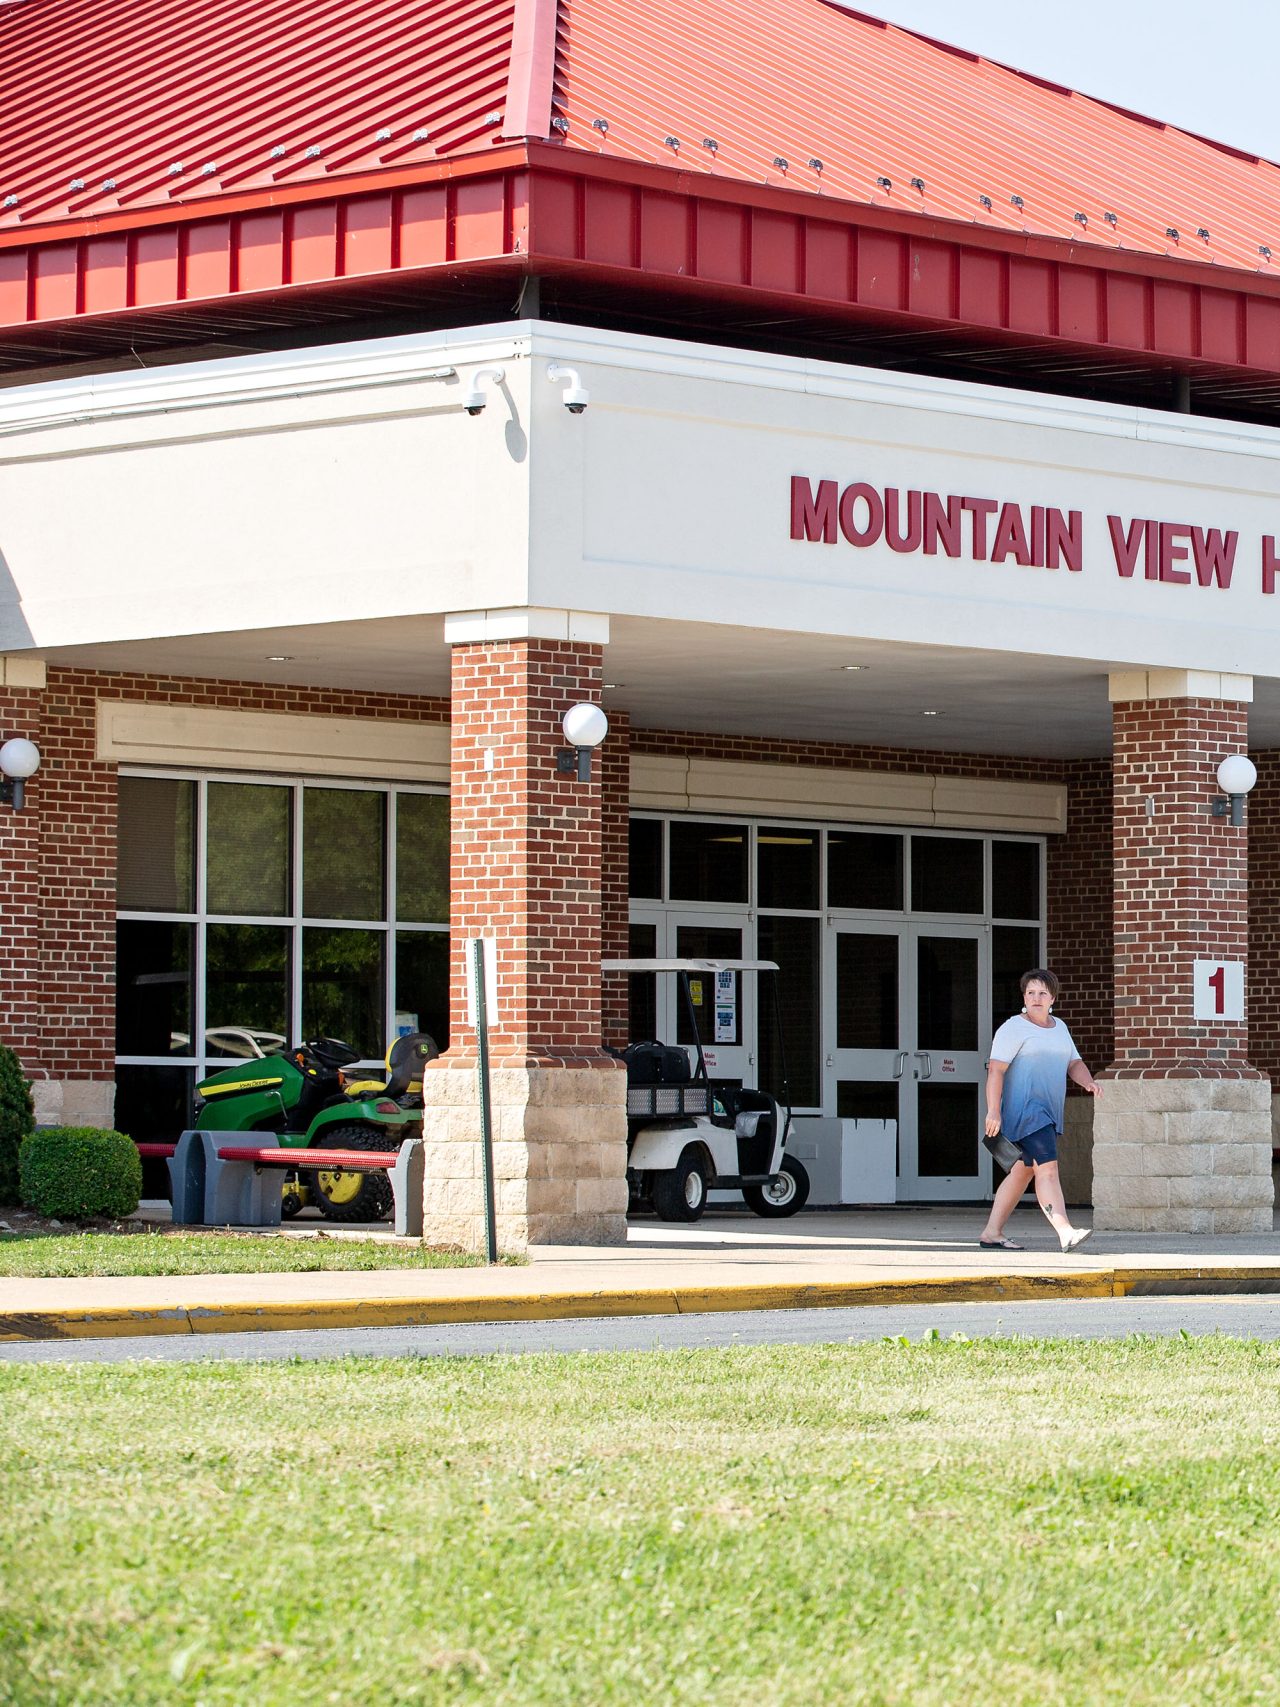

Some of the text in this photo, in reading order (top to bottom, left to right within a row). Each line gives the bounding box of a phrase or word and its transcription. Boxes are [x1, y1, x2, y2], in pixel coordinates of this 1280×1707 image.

[790, 475, 1083, 572] MOUNTAIN
[1107, 514, 1239, 589] VIEW
[1208, 966, 1225, 1015] 1
[252, 1079, 268, 1087] DEERE
[941, 1065, 955, 1073] Office
